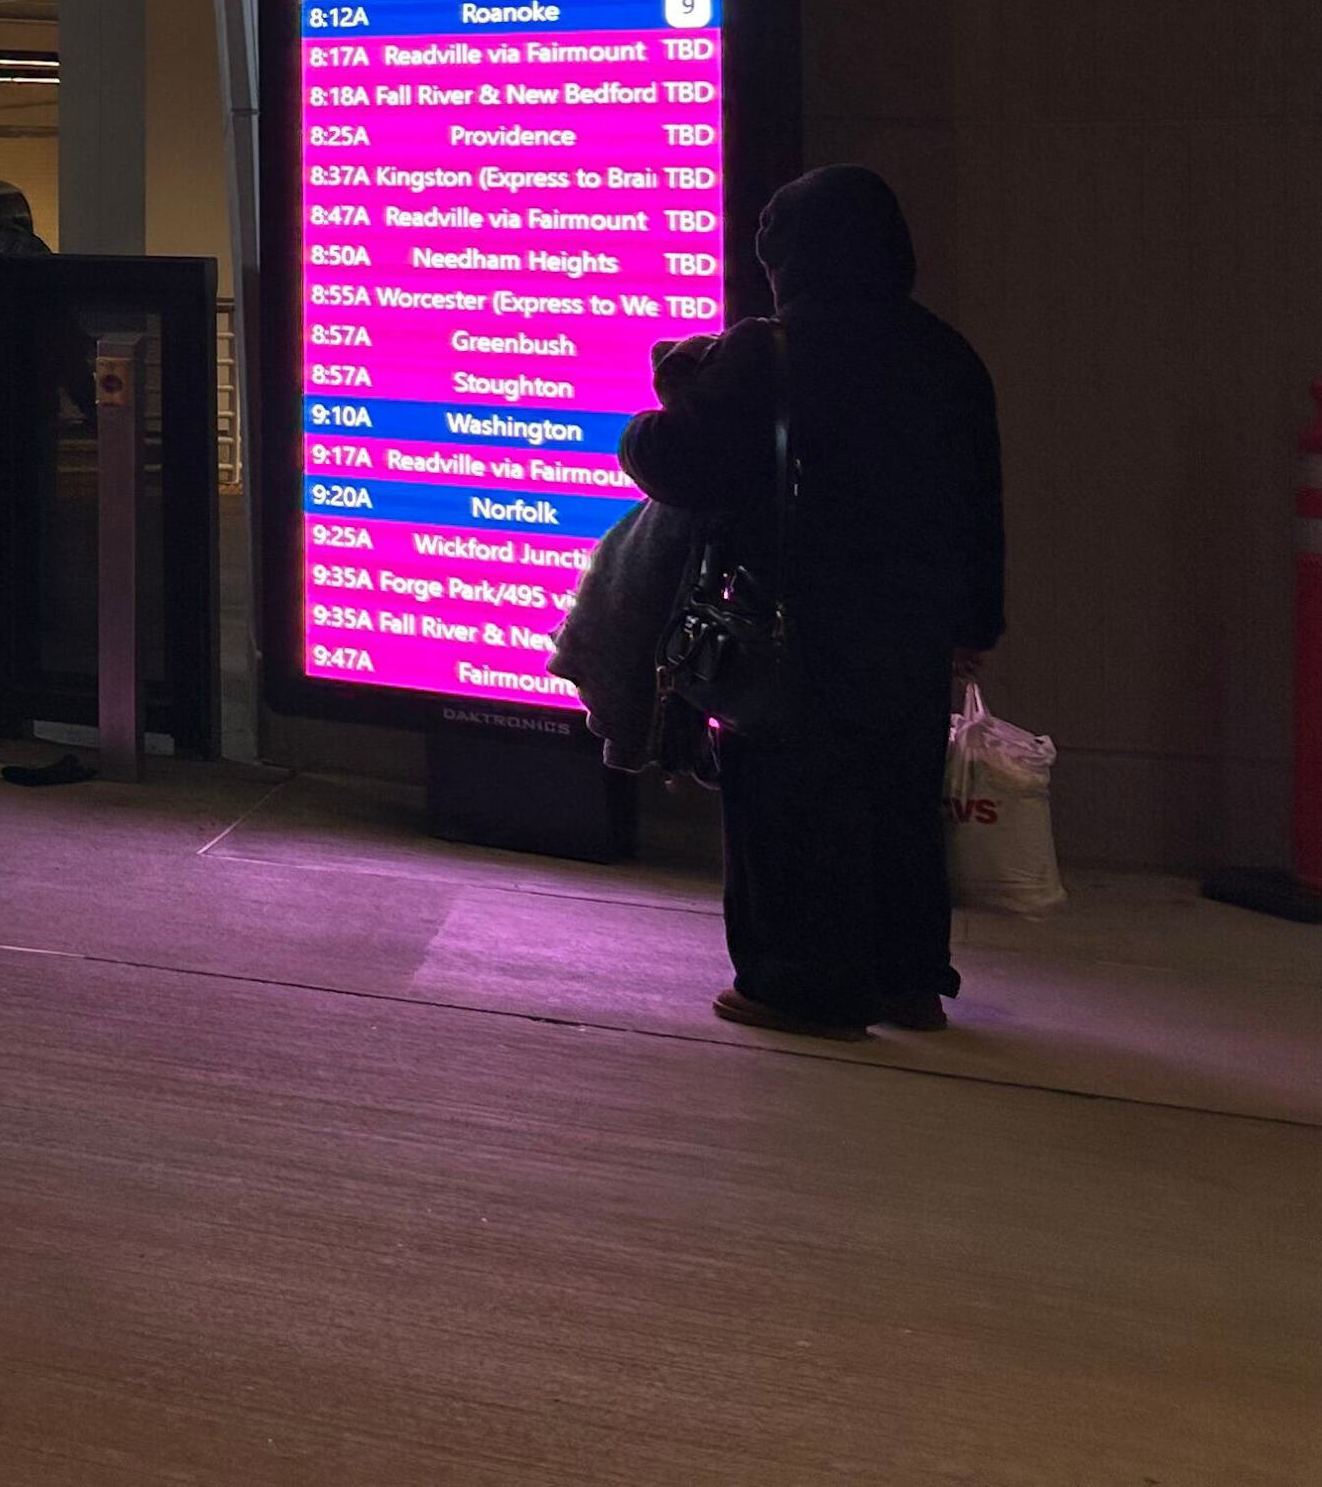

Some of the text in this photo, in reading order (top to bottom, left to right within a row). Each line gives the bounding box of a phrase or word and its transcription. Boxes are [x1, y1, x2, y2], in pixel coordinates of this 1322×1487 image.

[310, 7, 369, 27] 8:12A
[463, 0, 560, 23] Roanoke
[310, 39, 714, 66] 8:17A Readville via Fairmount TBD
[310, 82, 714, 106] 8:18A Fall River & New Bedford TBD
[311, 125, 714, 145] 8:25A Providence TBD
[311, 166, 715, 192] 8:37A Kingston (Express to Brai TBD
[311, 206, 715, 232] 8:47A Readville via Fairmount TBD
[311, 245, 717, 278] 8:50A Needham Heights TBD
[312, 285, 717, 318] 8:55A Worcester (Express to We TBD
[312, 325, 574, 355] 8:57A Greenbush
[312, 365, 573, 401] 8:57A Stoughton
[311, 404, 582, 445] 9:10A Washington
[312, 444, 371, 466] 9:17A
[388, 450, 485, 476] Readville
[491, 459, 523, 479] via
[311, 484, 559, 524] 9:20A Norfolk
[313, 525, 592, 573] 9:25A Wickford Juncti
[313, 565, 373, 589] 9:35A
[381, 571, 442, 601] Forge
[450, 578, 545, 607] Park/495
[313, 605, 372, 629] 9:35A
[380, 612, 414, 634] Fall
[422, 617, 477, 641] River
[483, 624, 505, 645] &
[314, 645, 373, 670] 9:47A
[443, 708, 570, 734] DAKTRONICS
